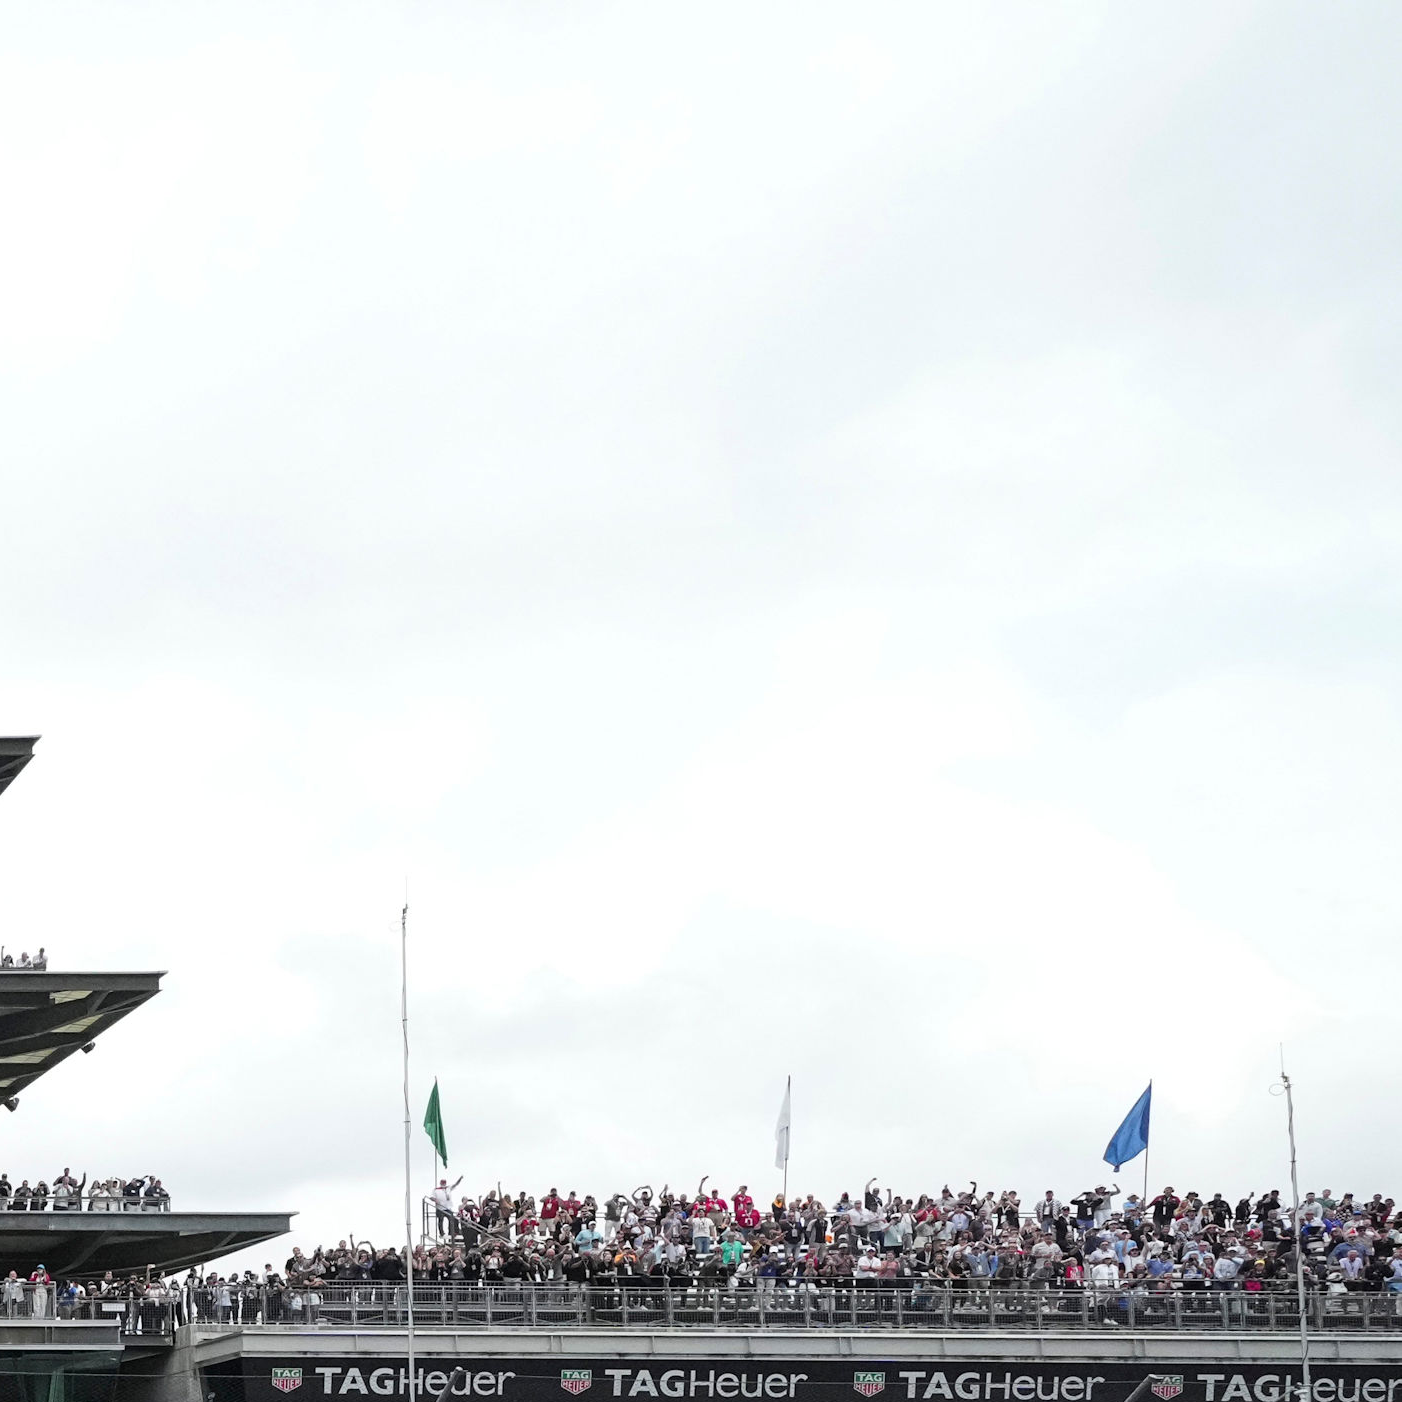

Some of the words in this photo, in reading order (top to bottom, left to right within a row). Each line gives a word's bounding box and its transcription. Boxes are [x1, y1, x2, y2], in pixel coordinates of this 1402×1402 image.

[274, 1369, 300, 1377] TAG
[563, 1371, 589, 1379] TAG
[856, 1373, 883, 1382] TAG
[273, 1378, 302, 1391] HEUER
[561, 1380, 591, 1393] HEUER
[854, 1383, 885, 1396] HEUER
[1152, 1385, 1183, 1399] HEUER
